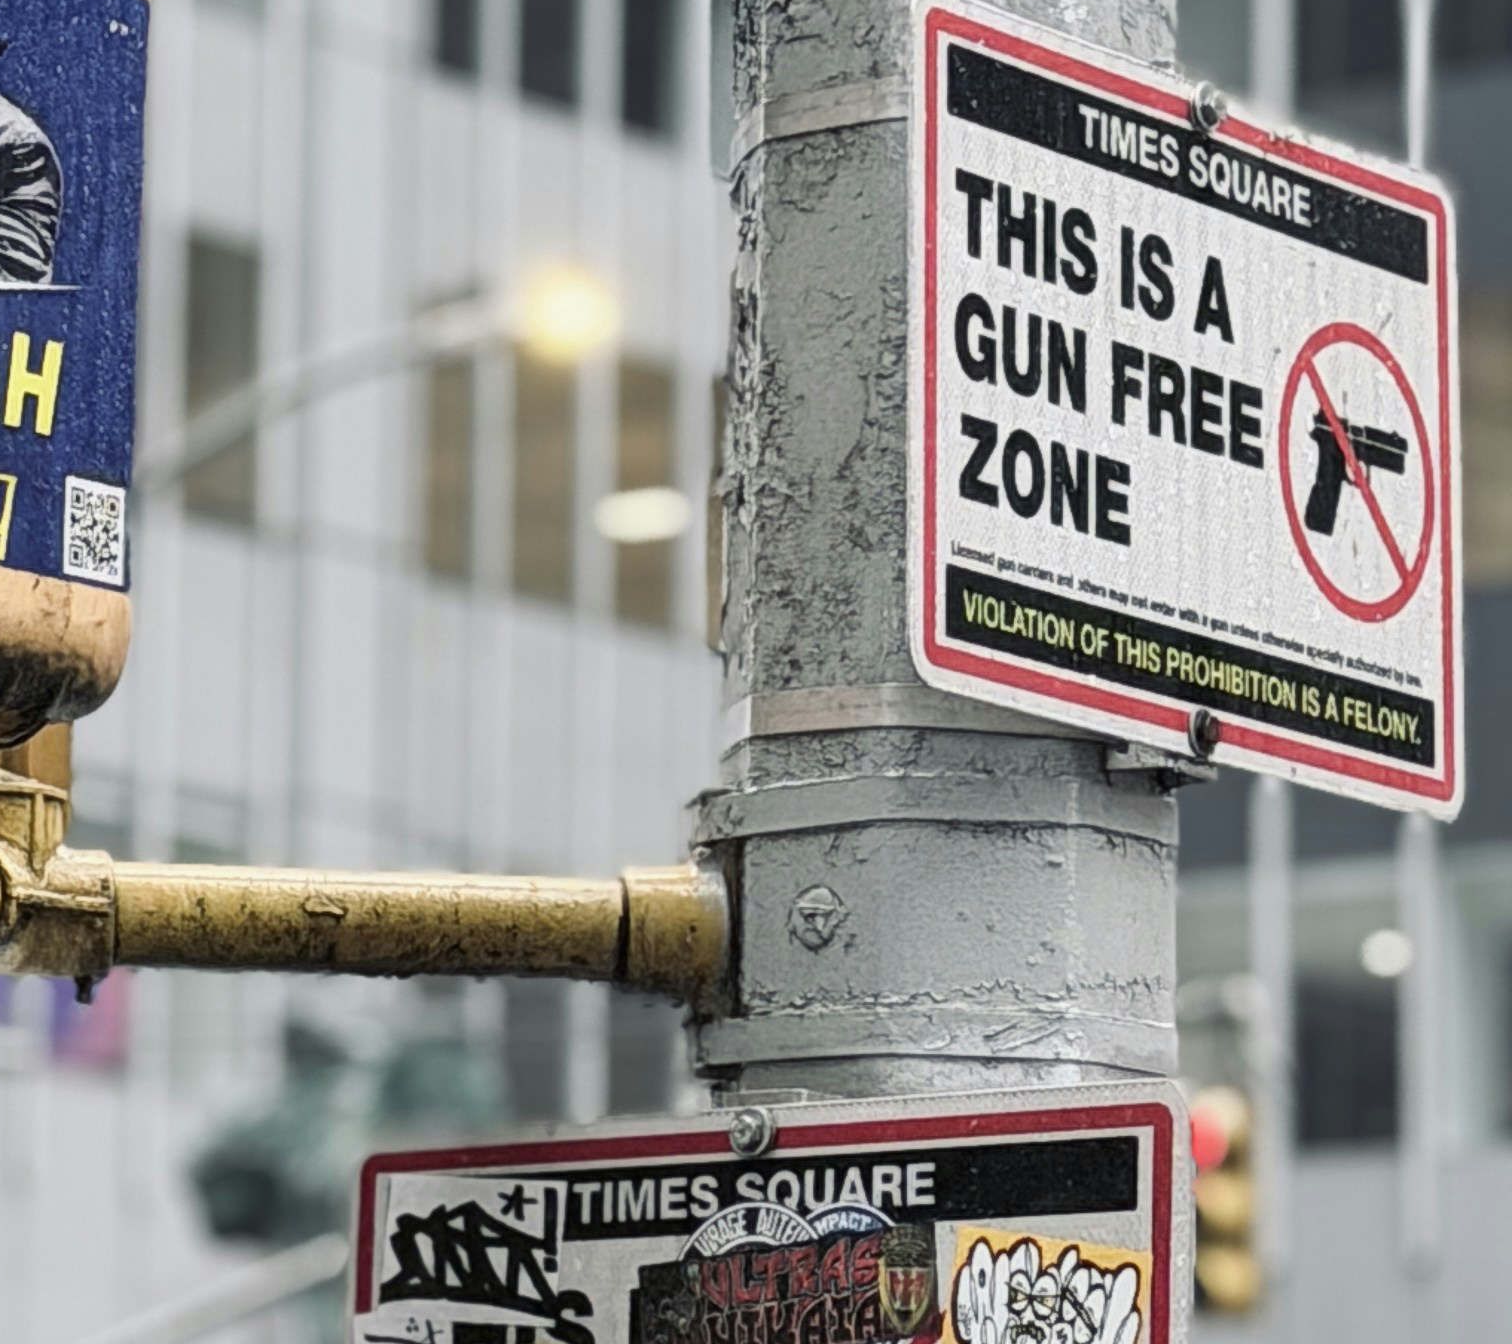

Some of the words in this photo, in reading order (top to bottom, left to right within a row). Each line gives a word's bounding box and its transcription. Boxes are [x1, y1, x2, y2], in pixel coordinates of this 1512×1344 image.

[1080, 104, 1180, 177] TIMES
[1189, 147, 1312, 227] SQUARE
[955, 169, 1099, 295] THIS
[1120, 225, 1176, 322] IS
[1194, 257, 1235, 345] A
[954, 292, 1088, 414] GUN
[1111, 343, 1265, 468] FREE
[957, 414, 1133, 547] ZONE
[963, 588, 1075, 650] VIOLATION
[1080, 623, 1110, 658] OF
[1114, 632, 1162, 674] THIS
[1166, 646, 1296, 712] PROHIBITION
[1302, 684, 1320, 717] IS
[1325, 693, 1339, 722] A
[1343, 697, 1422, 744] FELONY.
[572, 1175, 720, 1225] TIMES
[735, 1162, 937, 1212] SQUARE
